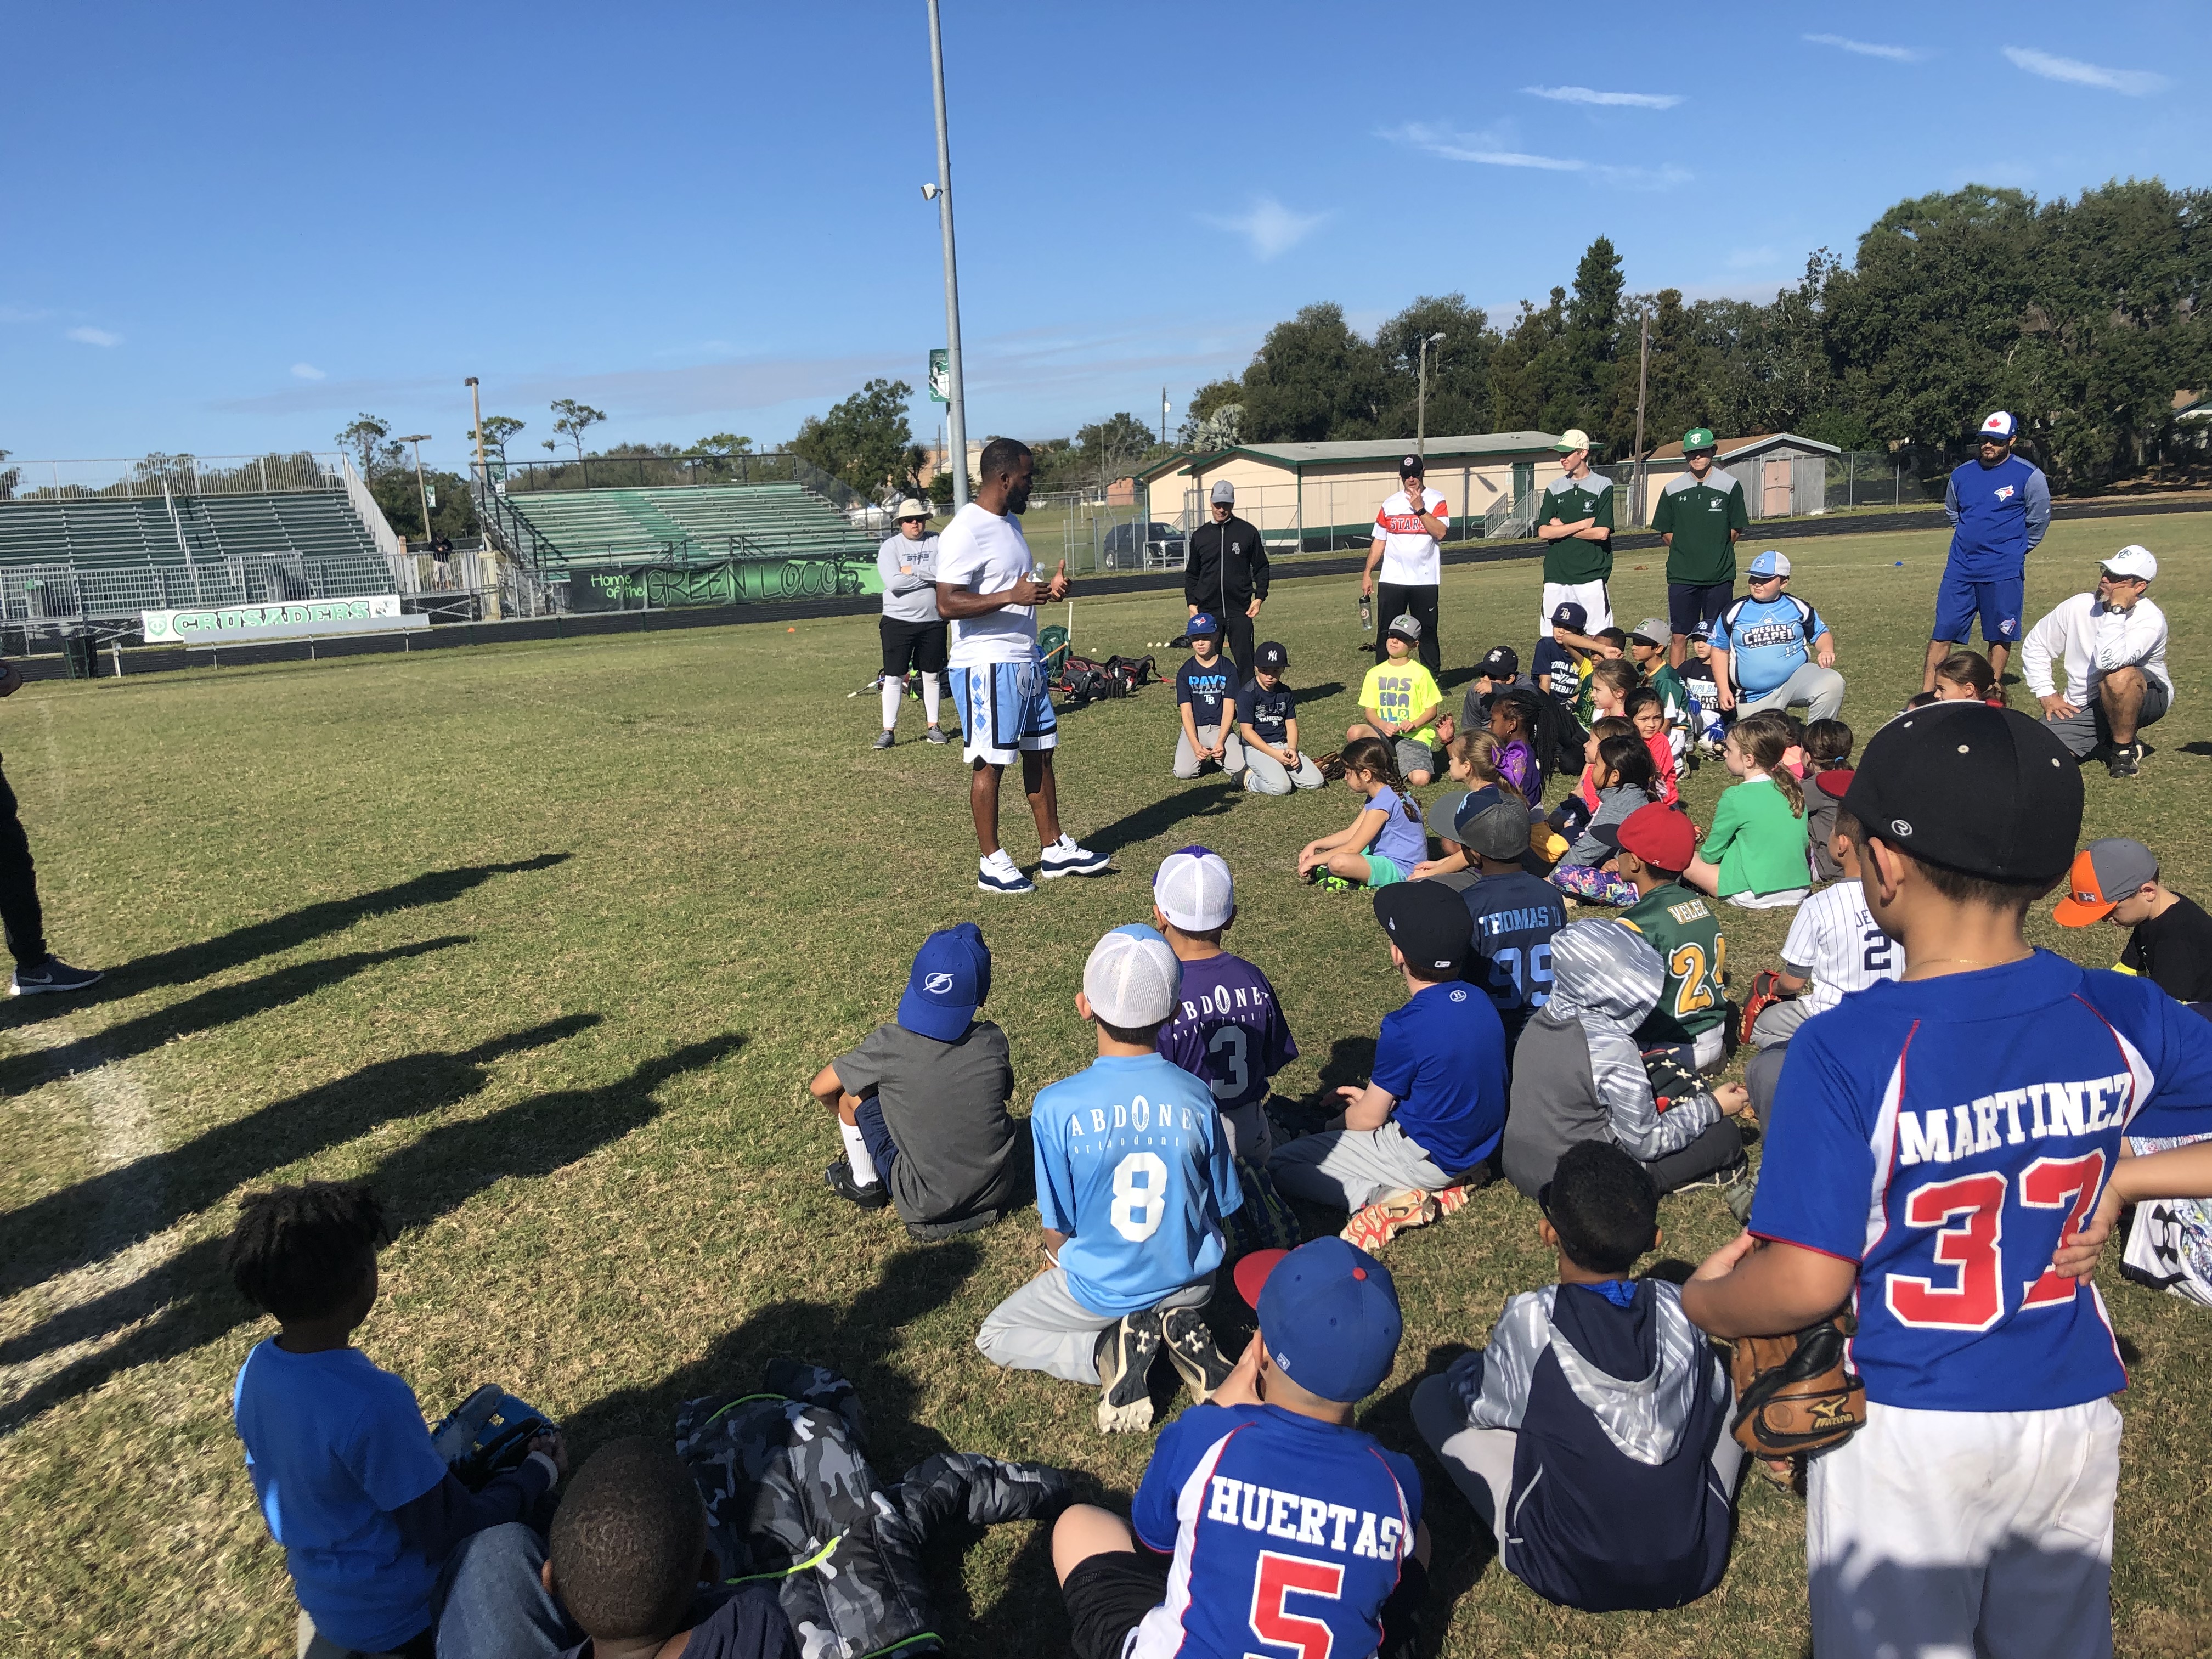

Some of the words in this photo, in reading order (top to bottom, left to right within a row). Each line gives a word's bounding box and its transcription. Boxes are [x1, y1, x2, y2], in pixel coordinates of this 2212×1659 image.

[591, 574, 633, 587] Home
[606, 585, 621, 599] of
[623, 585, 645, 597] the
[646, 562, 748, 606] GREEN
[760, 557, 859, 599] LOCOS
[173, 600, 371, 635] CRUSADERS
[1744, 628, 1795, 645] CHAPEL
[1751, 624, 1787, 635] WESLEY
[1478, 906, 1549, 937] THOMAS
[1667, 898, 1711, 924] VELEZ
[1864, 929, 1892, 971] 2
[1209, 1025, 1249, 1100] 3
[1899, 1073, 2132, 1166] MARTINEZ
[1110, 1152, 1167, 1242] 8
[1207, 1475, 1404, 1560] HUERTAS
[1244, 1549, 1345, 1659] 5
